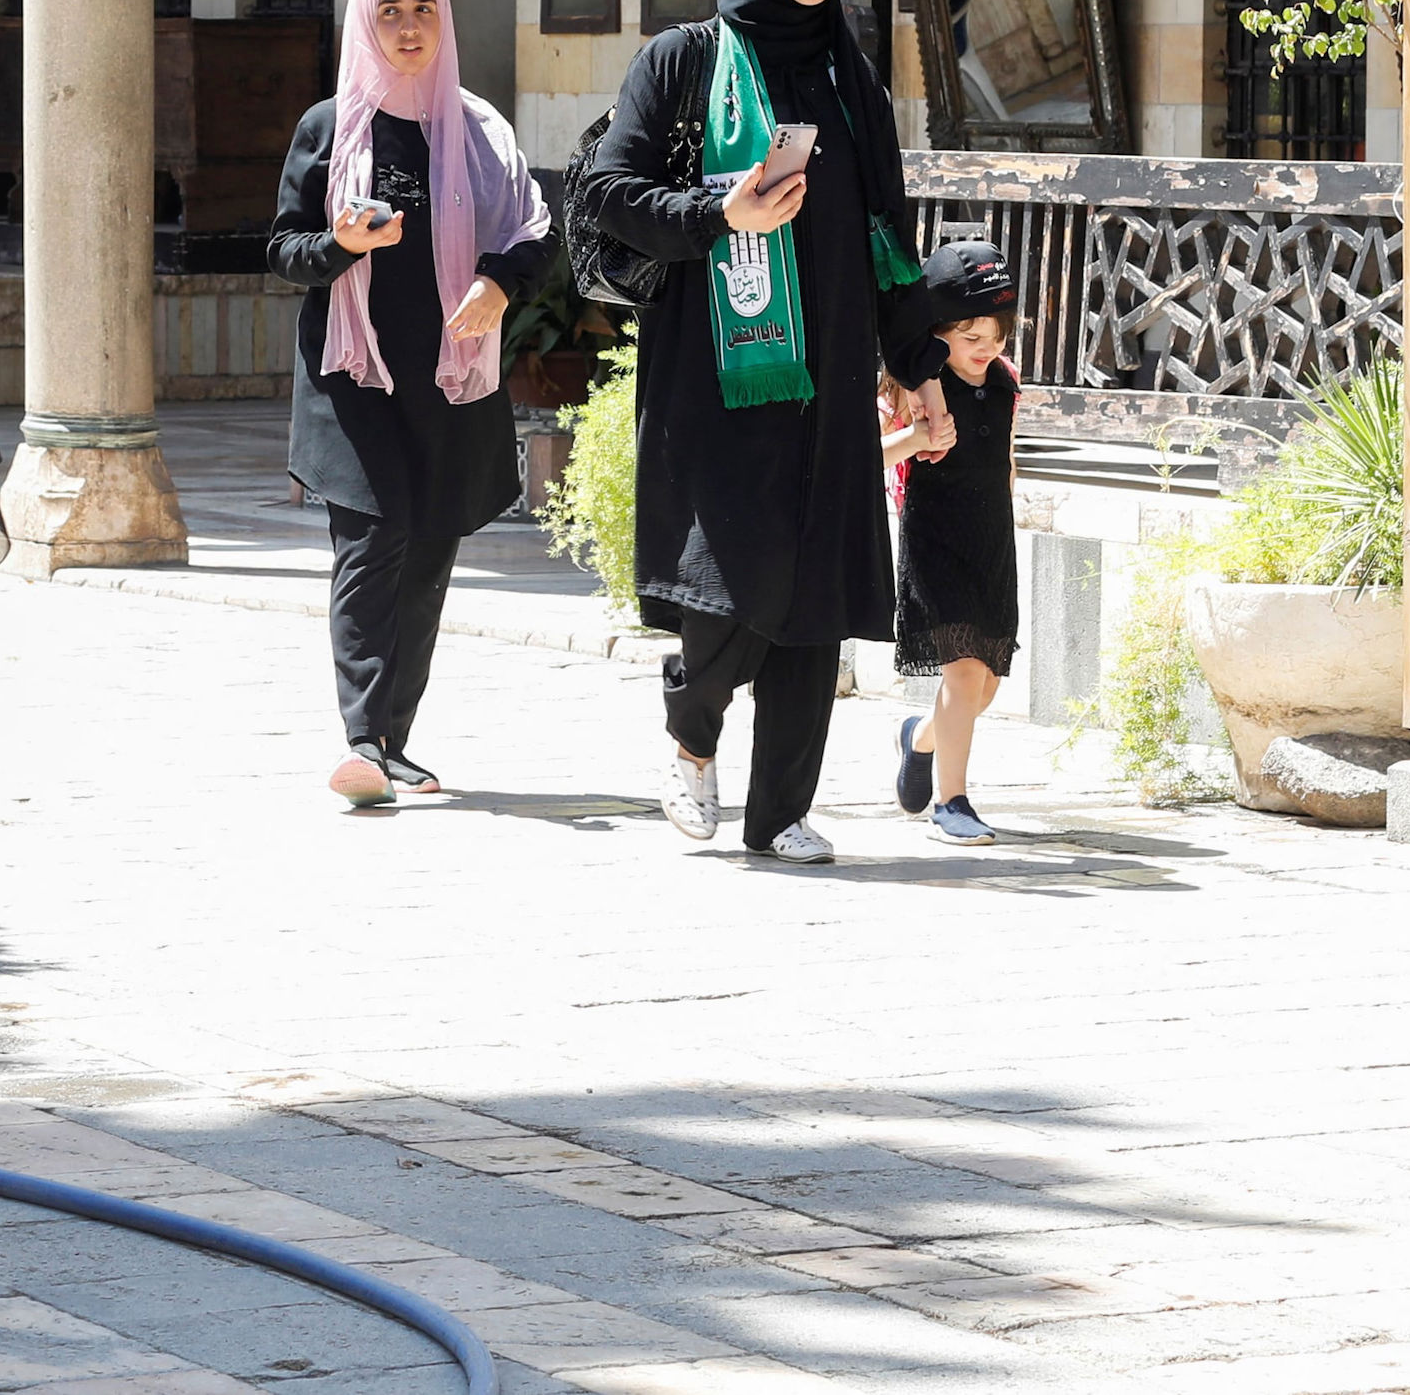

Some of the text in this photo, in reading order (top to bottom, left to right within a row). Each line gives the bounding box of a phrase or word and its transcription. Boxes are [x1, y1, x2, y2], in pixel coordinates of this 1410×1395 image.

[730, 272, 766, 305] العباس
[727, 324, 759, 350] الفضل
[774, 321, 787, 345] يا
